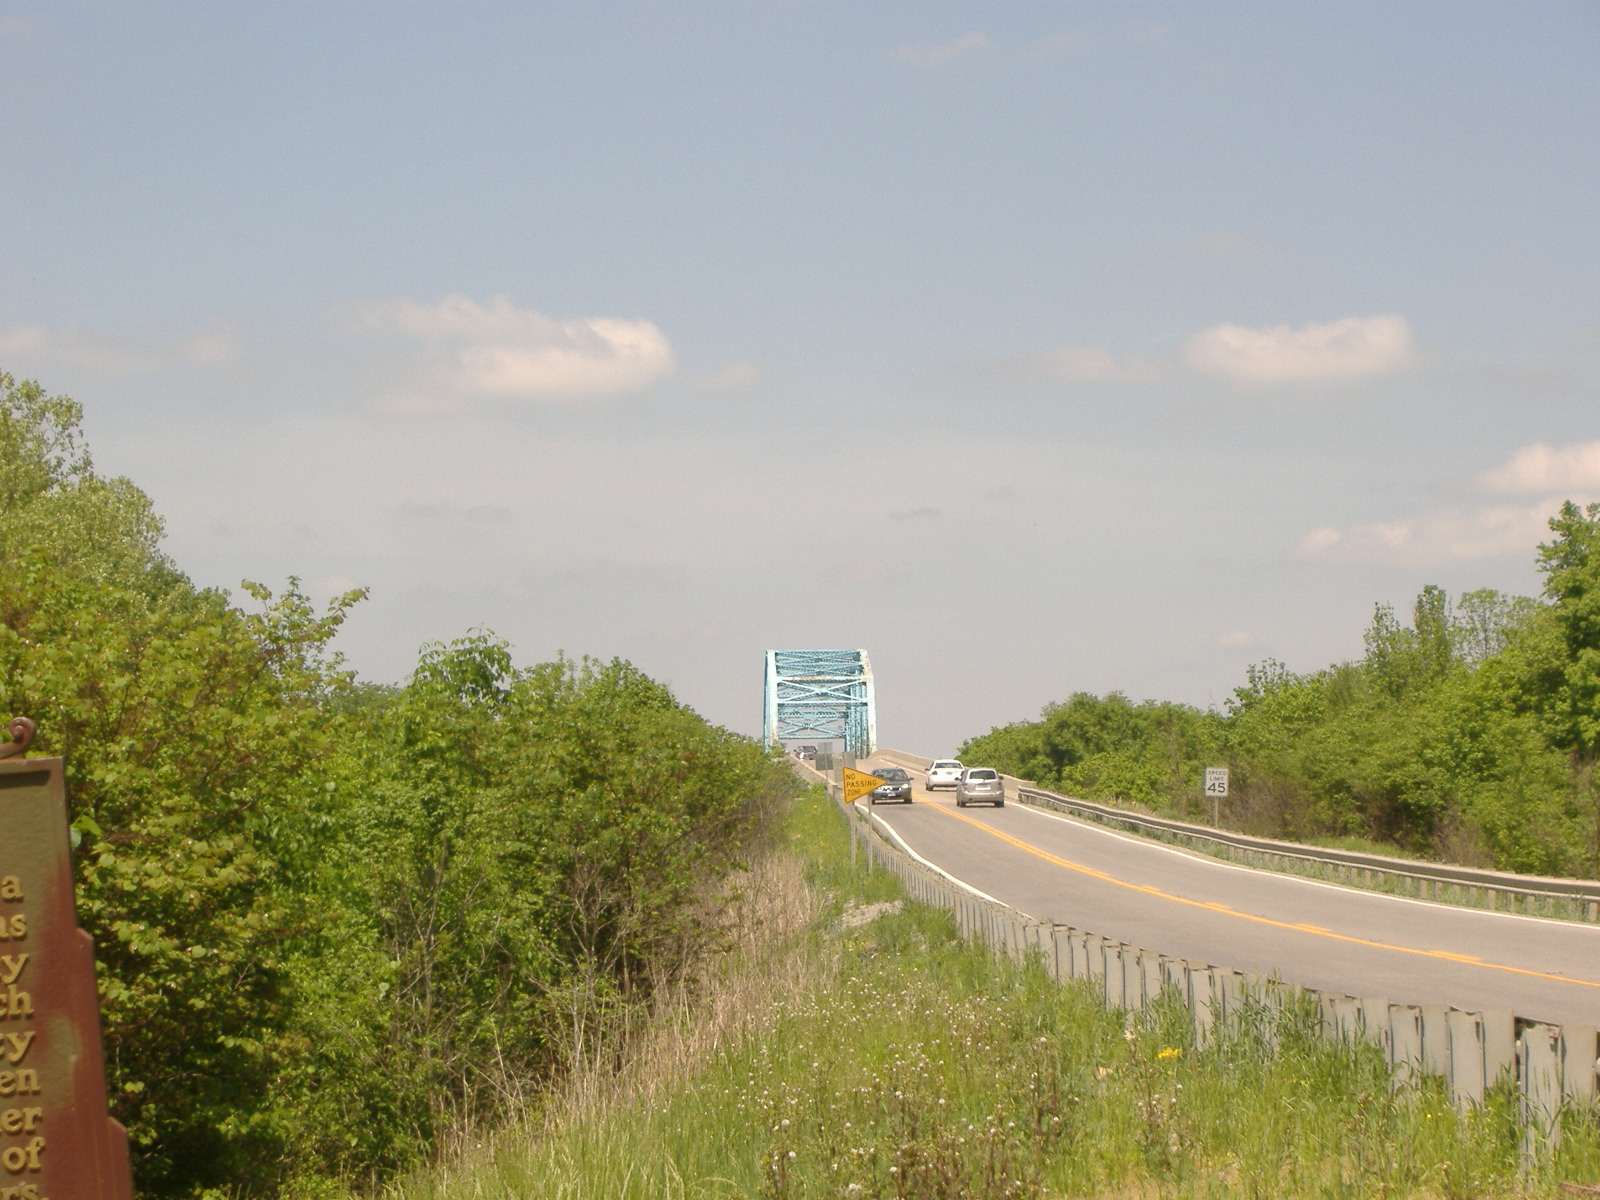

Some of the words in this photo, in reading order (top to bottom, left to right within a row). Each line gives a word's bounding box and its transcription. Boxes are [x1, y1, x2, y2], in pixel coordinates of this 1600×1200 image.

[846, 780, 877, 788] PASSING
[1207, 782, 1226, 793] 45
[847, 788, 861, 796] ZONE
[2, 1136, 46, 1171] of
